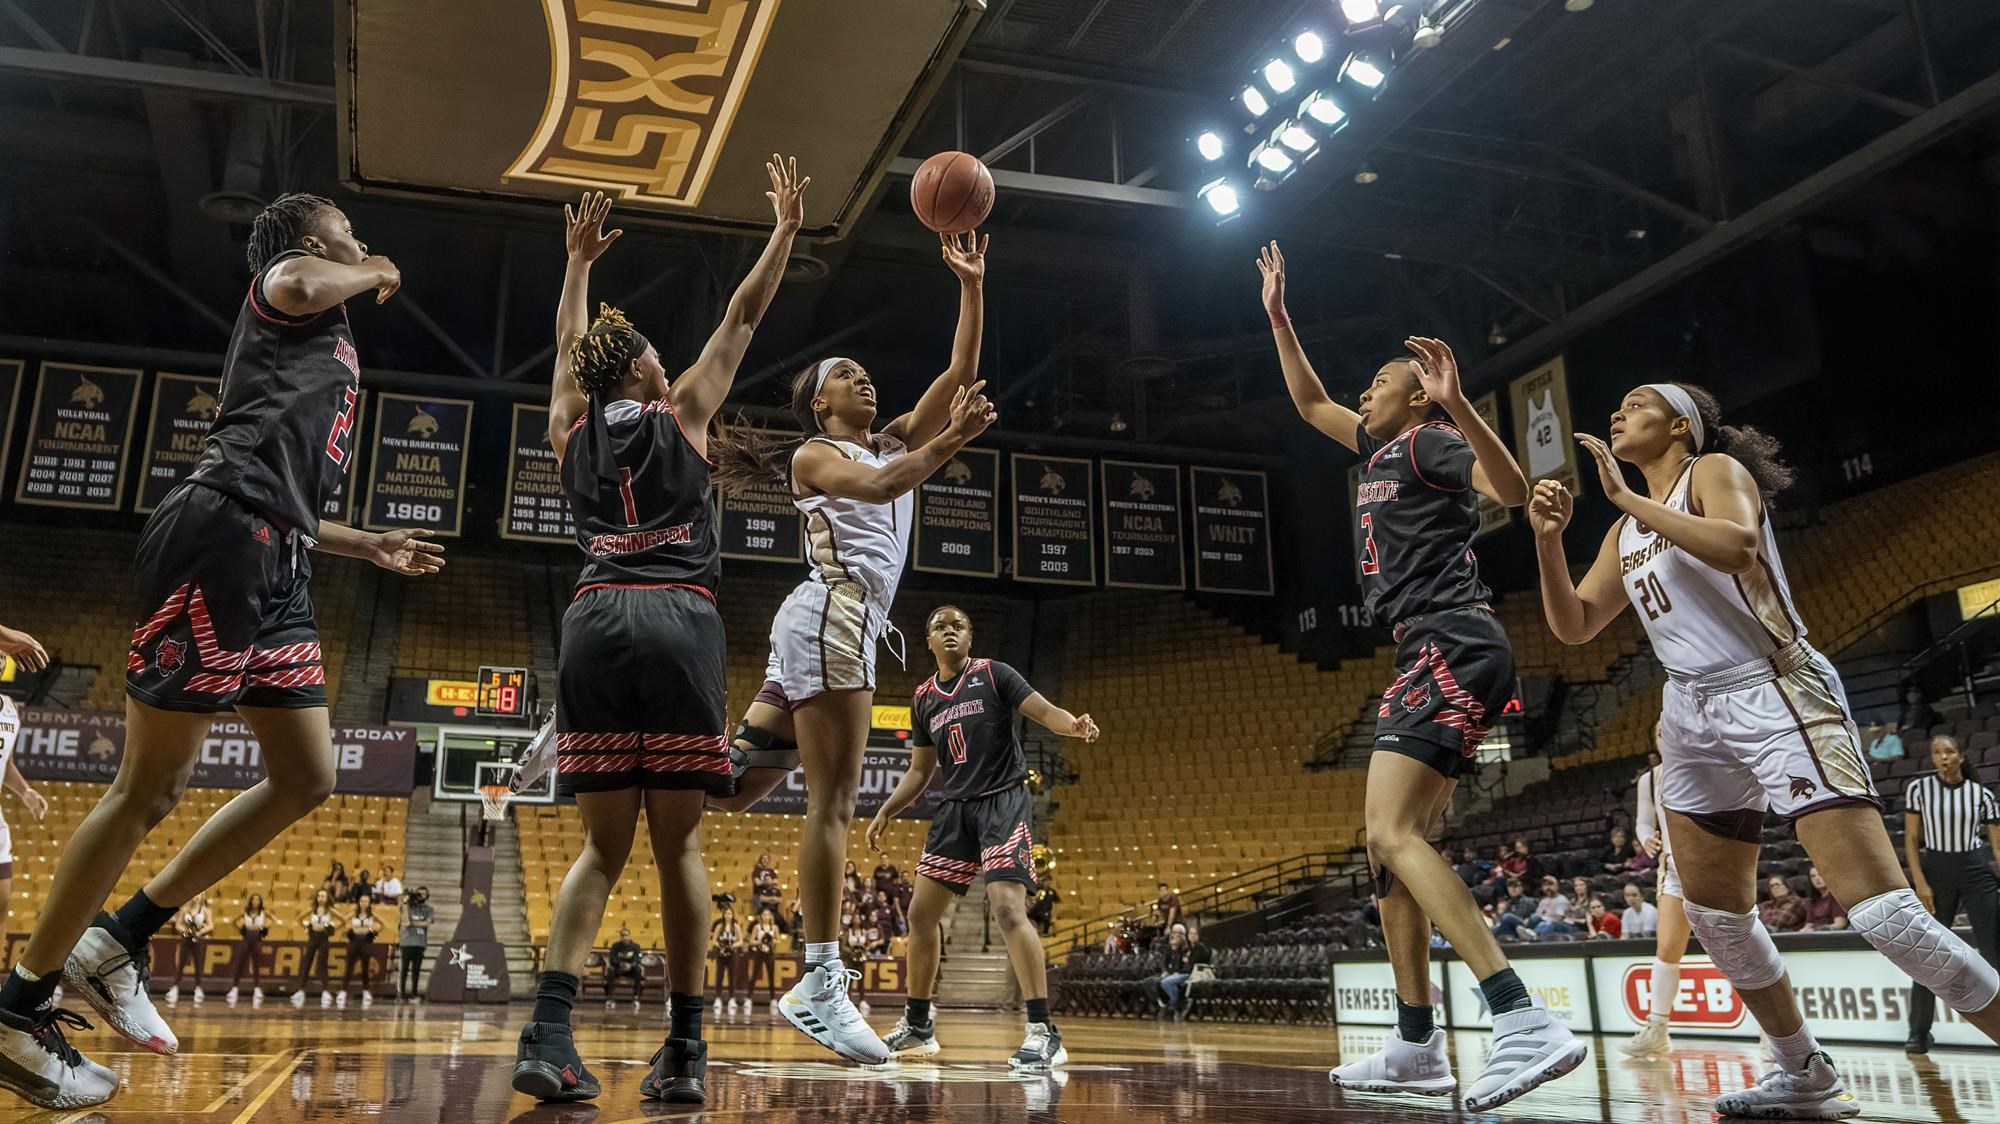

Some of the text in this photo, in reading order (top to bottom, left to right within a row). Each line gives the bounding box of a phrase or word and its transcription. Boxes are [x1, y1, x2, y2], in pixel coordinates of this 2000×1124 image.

[57, 408, 110, 421] VOLLEYBALL
[54, 421, 105, 442] NCAA
[326, 385, 358, 474] 2
[1536, 425, 1552, 447] 42
[38, 439, 119, 455] TOURNAMENT
[382, 436, 459, 451] MEN'S BASKETBALL
[517, 447, 543, 458] MEN'S
[395, 453, 441, 472] NAIA
[525, 460, 553, 472] LONE
[1841, 453, 1873, 481] 114
[385, 471, 449, 487] NATIONAL
[57, 484, 81, 496] 2011
[376, 483, 455, 499] CHAMPIONS
[617, 466, 639, 528] 1
[922, 483, 992, 497] WOMEN'S BASKETBALL
[928, 495, 986, 509] SOUTHLAND
[1019, 494, 1087, 507] WOMEN'S BASKETBALL
[1109, 500, 1176, 512] WOMEN'S BASKETBALL
[386, 502, 442, 522] 1960
[725, 501, 798, 516] CHAMPIONS
[925, 506, 989, 520] CONFERENCE
[1024, 506, 1082, 519] SOUTHLAND
[1227, 508, 1264, 518] BASKETBALL
[746, 518, 776, 532] 1994
[923, 516, 991, 531] CHAMPIONS
[1021, 516, 1087, 529] TOURNAMENT
[1123, 515, 1164, 531] NCAA
[1021, 526, 1087, 540] CHAMPIONS
[1112, 531, 1176, 543] TOURNAMENT
[1209, 524, 1257, 544] WNIT
[746, 536, 774, 549] 1997
[942, 542, 971, 555] 2008
[1041, 543, 1067, 555] 1997
[1361, 511, 1379, 576] 3
[1041, 560, 1069, 572] 2003
[1634, 570, 1673, 622] 20
[1299, 607, 1317, 633] 113
[1338, 604, 1372, 628] 113
[492, 673, 522, 687] 6 14
[959, 699, 985, 718] STATE
[210, 723, 256, 736] HOL
[343, 729, 407, 741] TODAY
[16, 727, 80, 757] THE
[199, 738, 261, 767] CAT
[948, 722, 967, 764] 0
[787, 768, 906, 795] CWD
[1338, 987, 1380, 1010] TEXAS
